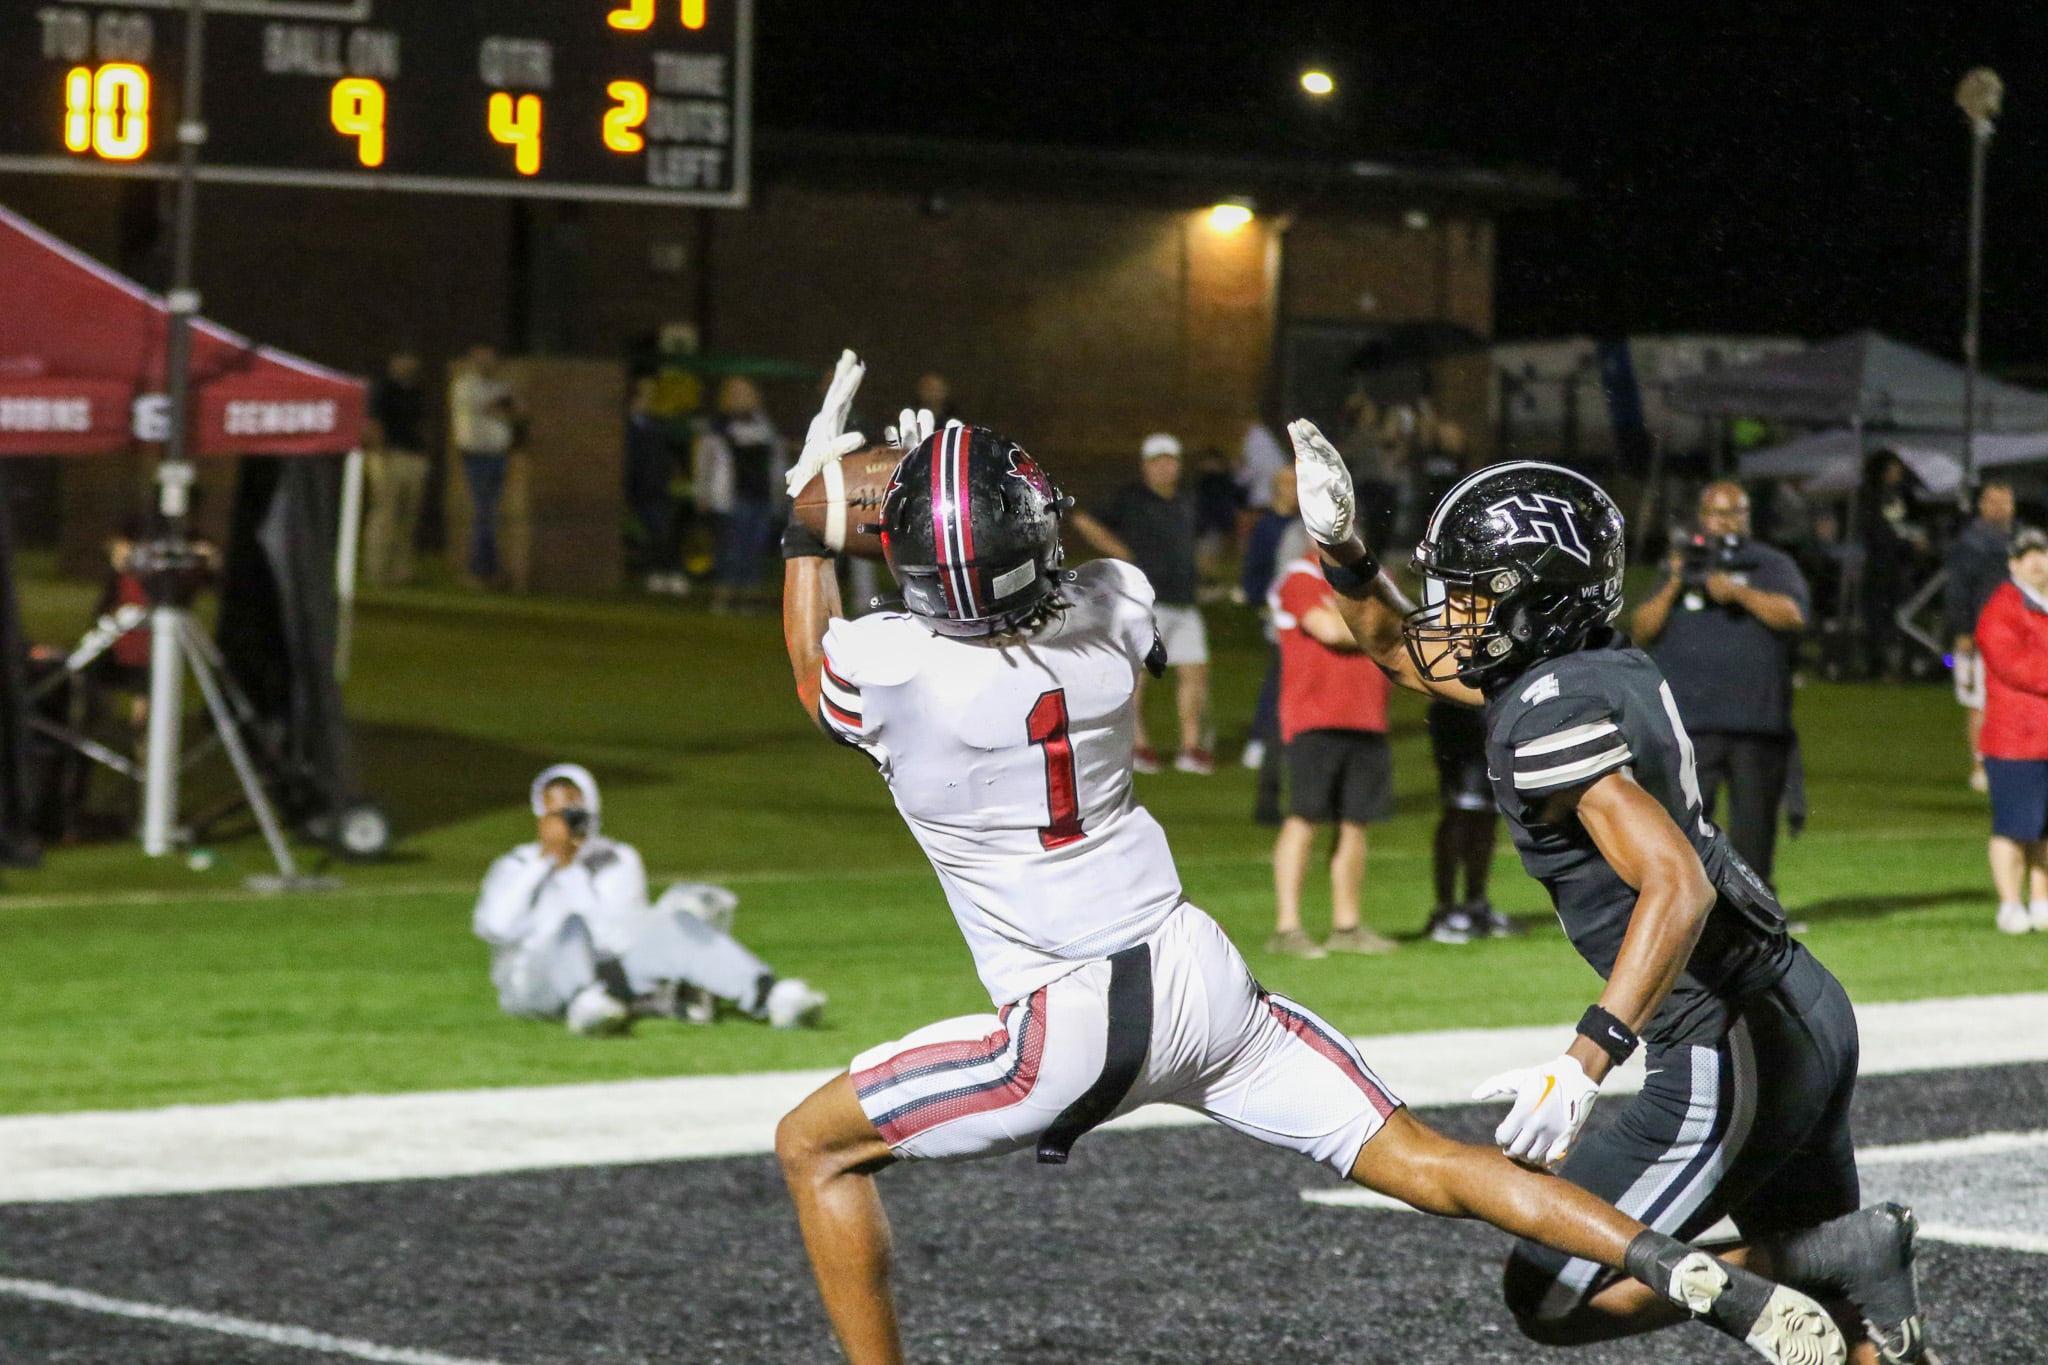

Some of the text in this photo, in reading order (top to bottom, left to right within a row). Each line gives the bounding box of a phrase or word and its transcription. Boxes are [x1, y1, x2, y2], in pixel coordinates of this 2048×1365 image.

[65, 62, 150, 160] 10
[331, 77, 386, 168] 9
[489, 91, 542, 176] 4
[602, 79, 648, 153] 2
[1486, 493, 1590, 567] H
[1581, 584, 1599, 598] WE
[1026, 687, 1088, 851] 1
